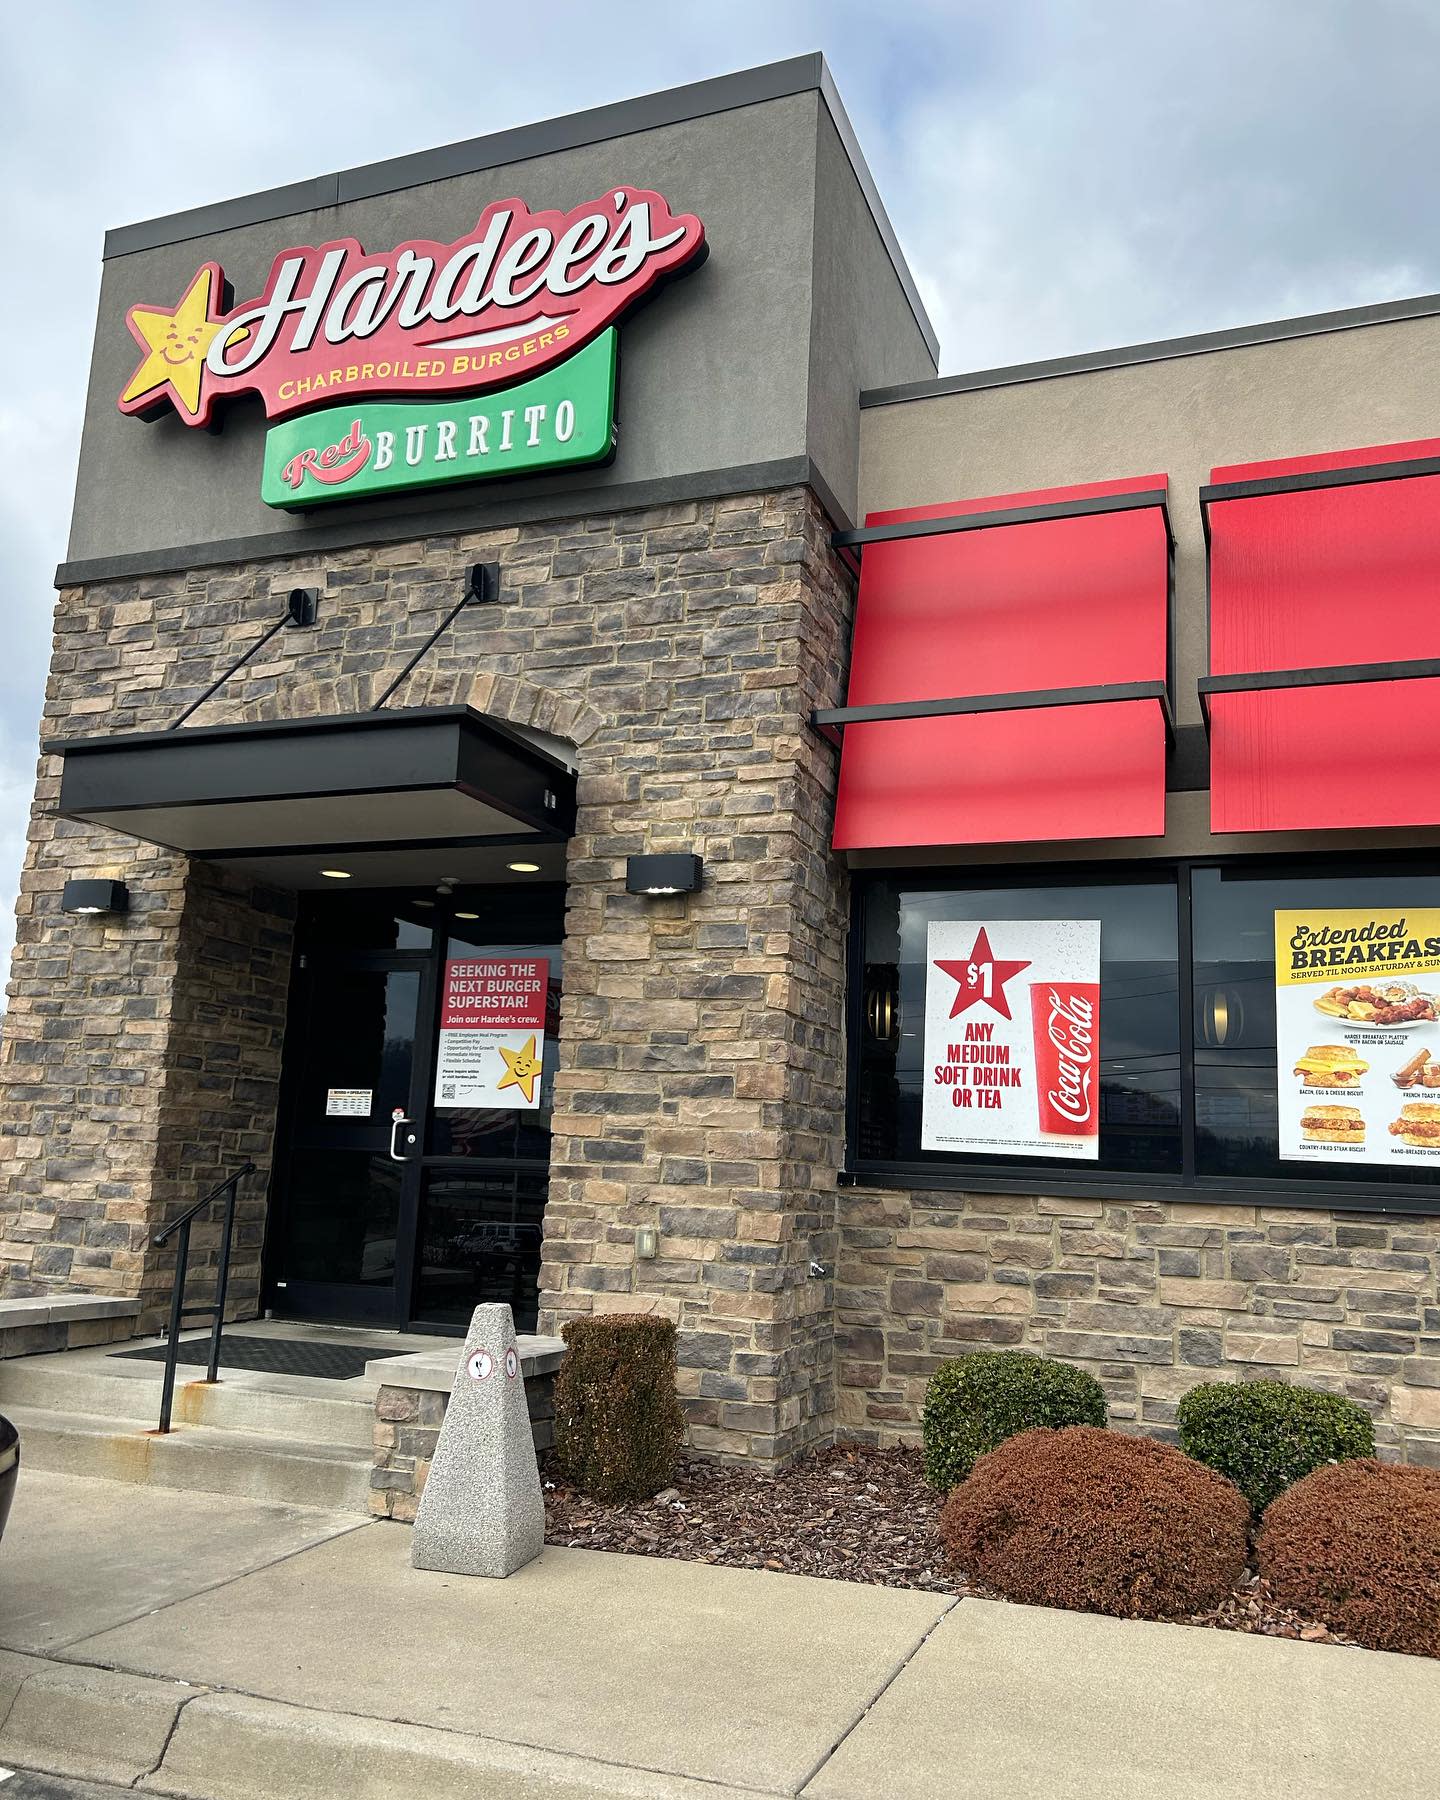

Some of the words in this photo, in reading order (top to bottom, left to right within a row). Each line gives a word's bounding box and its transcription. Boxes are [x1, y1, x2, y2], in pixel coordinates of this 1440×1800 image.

[206, 191, 686, 376] Hardee's
[278, 361, 446, 400] CHARBROILED
[452, 325, 570, 376] BURGERS
[281, 418, 372, 489] Red
[373, 399, 576, 471] BURRITO
[1290, 918, 1408, 950] Extended
[1291, 937, 1440, 969] BREAKFAS
[450, 965, 506, 977] SEEKING
[509, 964, 536, 976] THE
[967, 962, 993, 999] $1
[1291, 970, 1324, 979] SERVED
[1325, 968, 1340, 976] TIL
[1341, 966, 1367, 975] NOON
[1368, 961, 1415, 972] SATURDAY
[449, 981, 484, 992] NEXT
[487, 980, 541, 992] BURGER
[448, 996, 528, 1008] SUPERSTAR!
[446, 1015, 464, 1023] Join
[480, 1015, 516, 1023] Hardee's
[965, 1023, 994, 1042] ANY
[947, 1044, 1010, 1064] MEDIUM
[934, 1066, 968, 1086] SOFT
[973, 1066, 1021, 1087] DRINK
[952, 1088, 973, 1107] OR
[976, 1089, 1002, 1109] TEA
